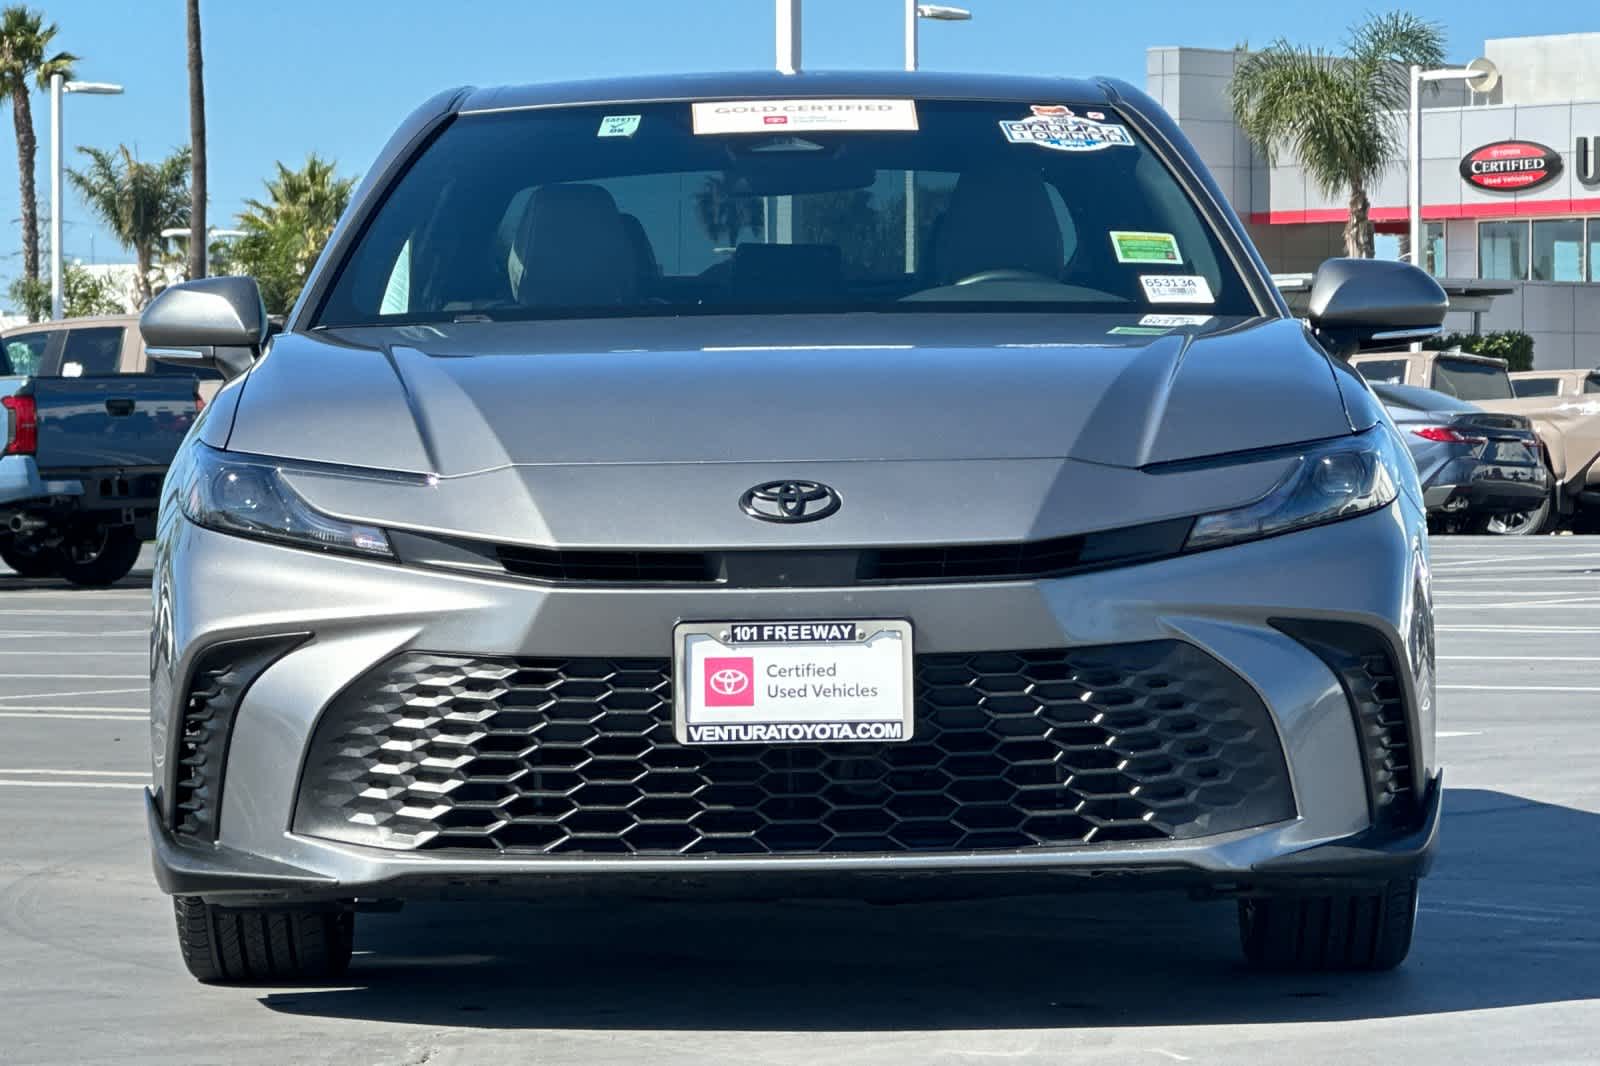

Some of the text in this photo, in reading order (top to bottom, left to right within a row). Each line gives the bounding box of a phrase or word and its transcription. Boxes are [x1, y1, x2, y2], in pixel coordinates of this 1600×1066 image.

[714, 103, 893, 114] GOLD CERTIFIED
[733, 624, 853, 640] 101 FREEWAY
[766, 663, 837, 678] Certified
[767, 683, 878, 698] Used Vehicles
[688, 723, 902, 742] VENTURATOYOTA.COM
